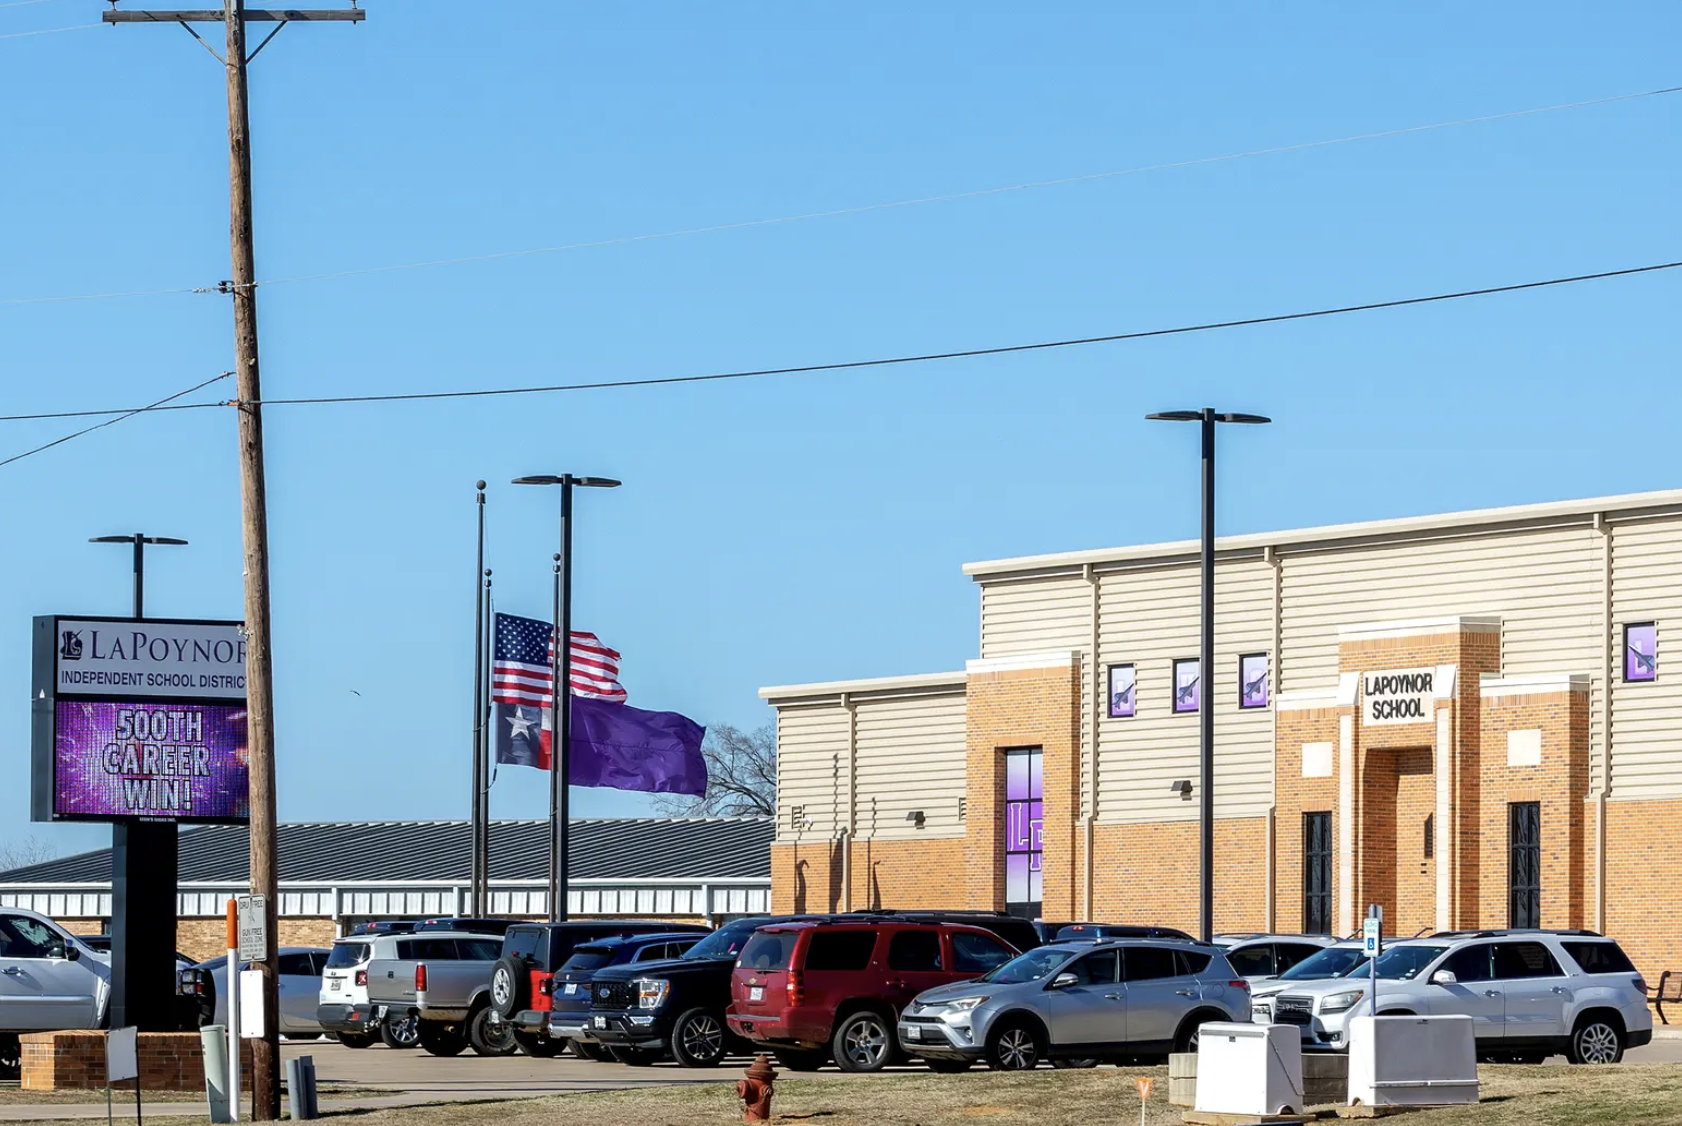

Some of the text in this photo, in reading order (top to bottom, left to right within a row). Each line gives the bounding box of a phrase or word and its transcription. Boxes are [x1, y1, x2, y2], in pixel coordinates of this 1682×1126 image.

[61, 671, 247, 689] INDEPENDENT SCHOOL DISTRIC
[1365, 673, 1433, 696] LAPOYNOR
[1372, 698, 1425, 720] SCHOOL
[116, 709, 203, 742] 500TH
[103, 743, 211, 777] CAREER
[123, 778, 193, 811] WIN!
